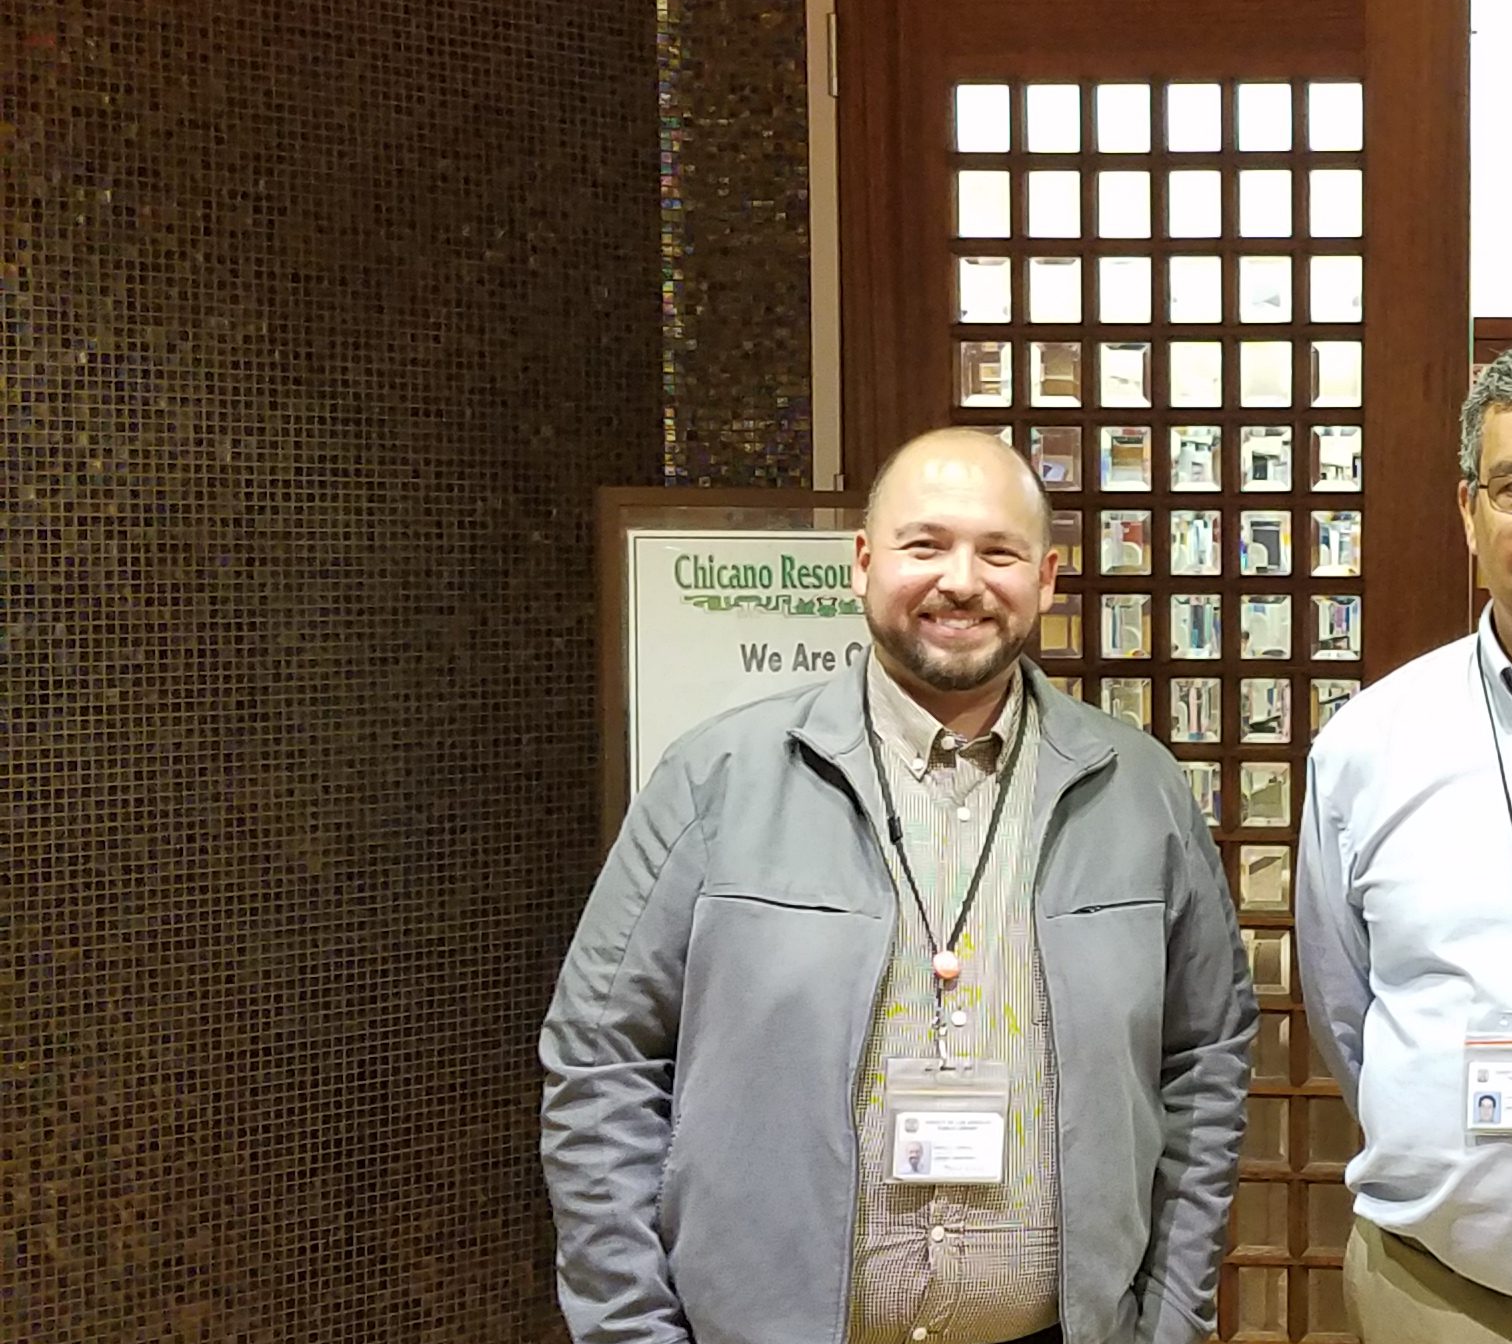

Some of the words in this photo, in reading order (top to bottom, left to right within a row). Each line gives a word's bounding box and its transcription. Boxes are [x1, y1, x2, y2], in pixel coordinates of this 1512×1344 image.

[673, 553, 773, 590] Chicano
[740, 642, 783, 673] We
[791, 642, 837, 672] Are
